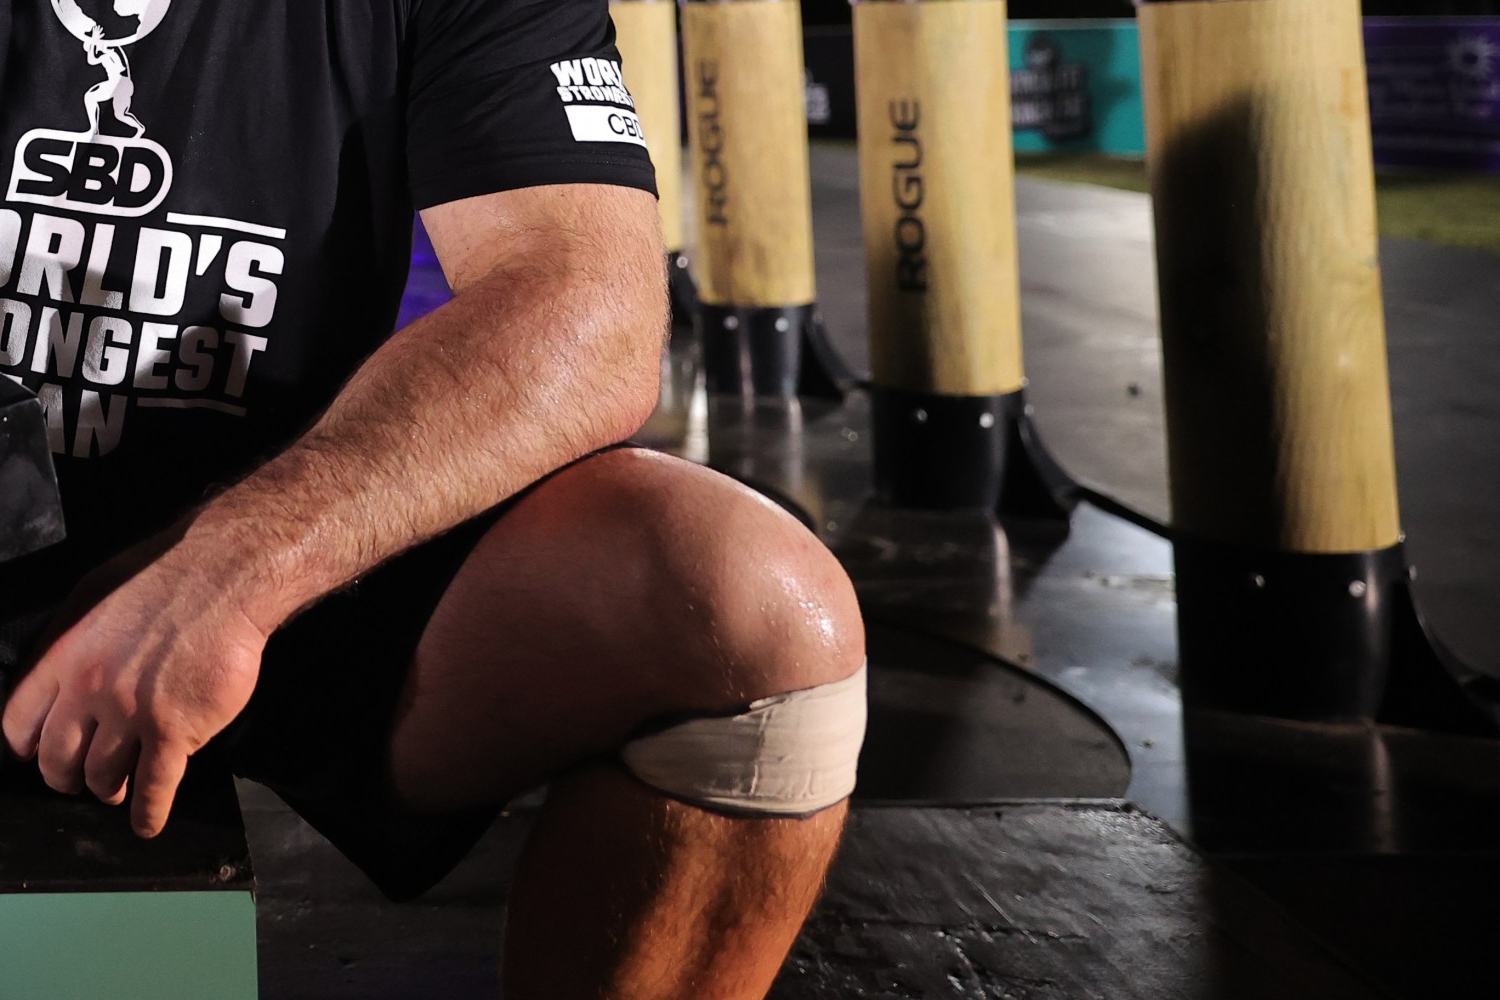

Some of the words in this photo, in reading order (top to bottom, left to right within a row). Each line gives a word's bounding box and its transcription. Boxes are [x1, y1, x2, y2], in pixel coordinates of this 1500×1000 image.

[15, 138, 166, 208] SBD
[696, 60, 727, 226] ROGUE
[890, 97, 927, 293] ROGUE
[3, 373, 128, 458] AN
